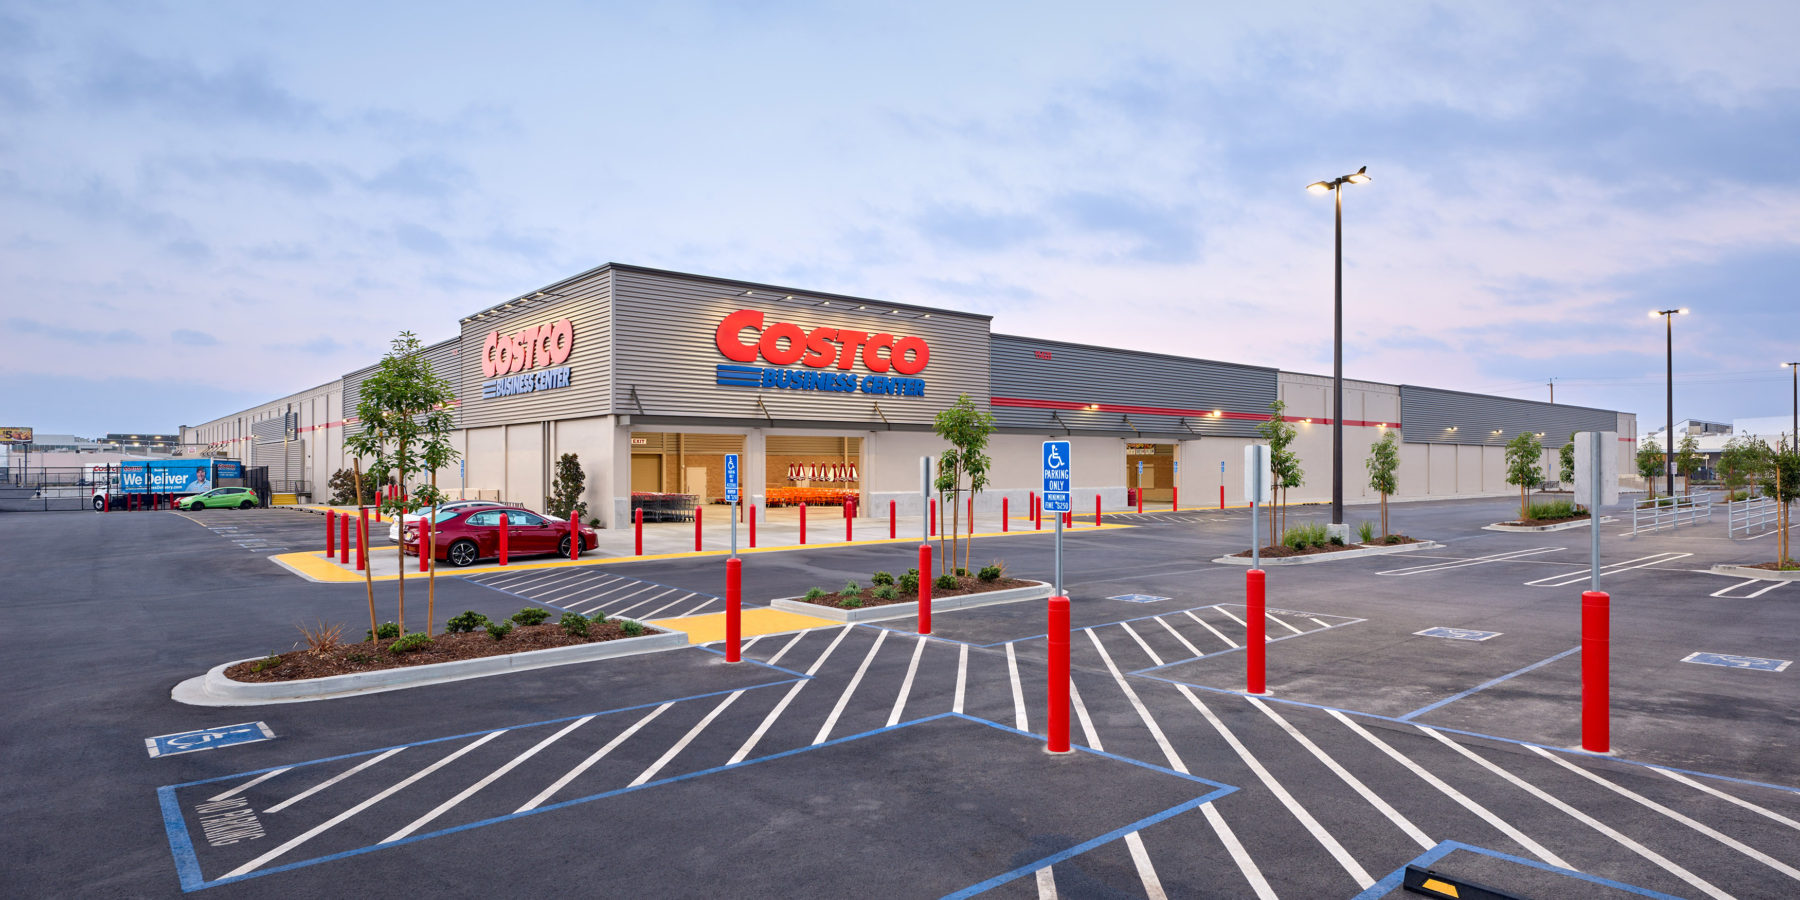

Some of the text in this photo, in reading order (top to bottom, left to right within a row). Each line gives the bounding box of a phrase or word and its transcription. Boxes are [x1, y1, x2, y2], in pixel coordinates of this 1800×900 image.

[481, 318, 573, 378] COSTCO
[715, 309, 930, 375] COSTCO
[496, 367, 572, 397] BUSINESS CENTER
[762, 368, 926, 397] BUSINESS CENTER
[123, 472, 189, 486] We Deliver
[1044, 469, 1069, 480] PARKING
[1049, 480, 1064, 490] ONLY
[1054, 502, 1068, 510] $250
